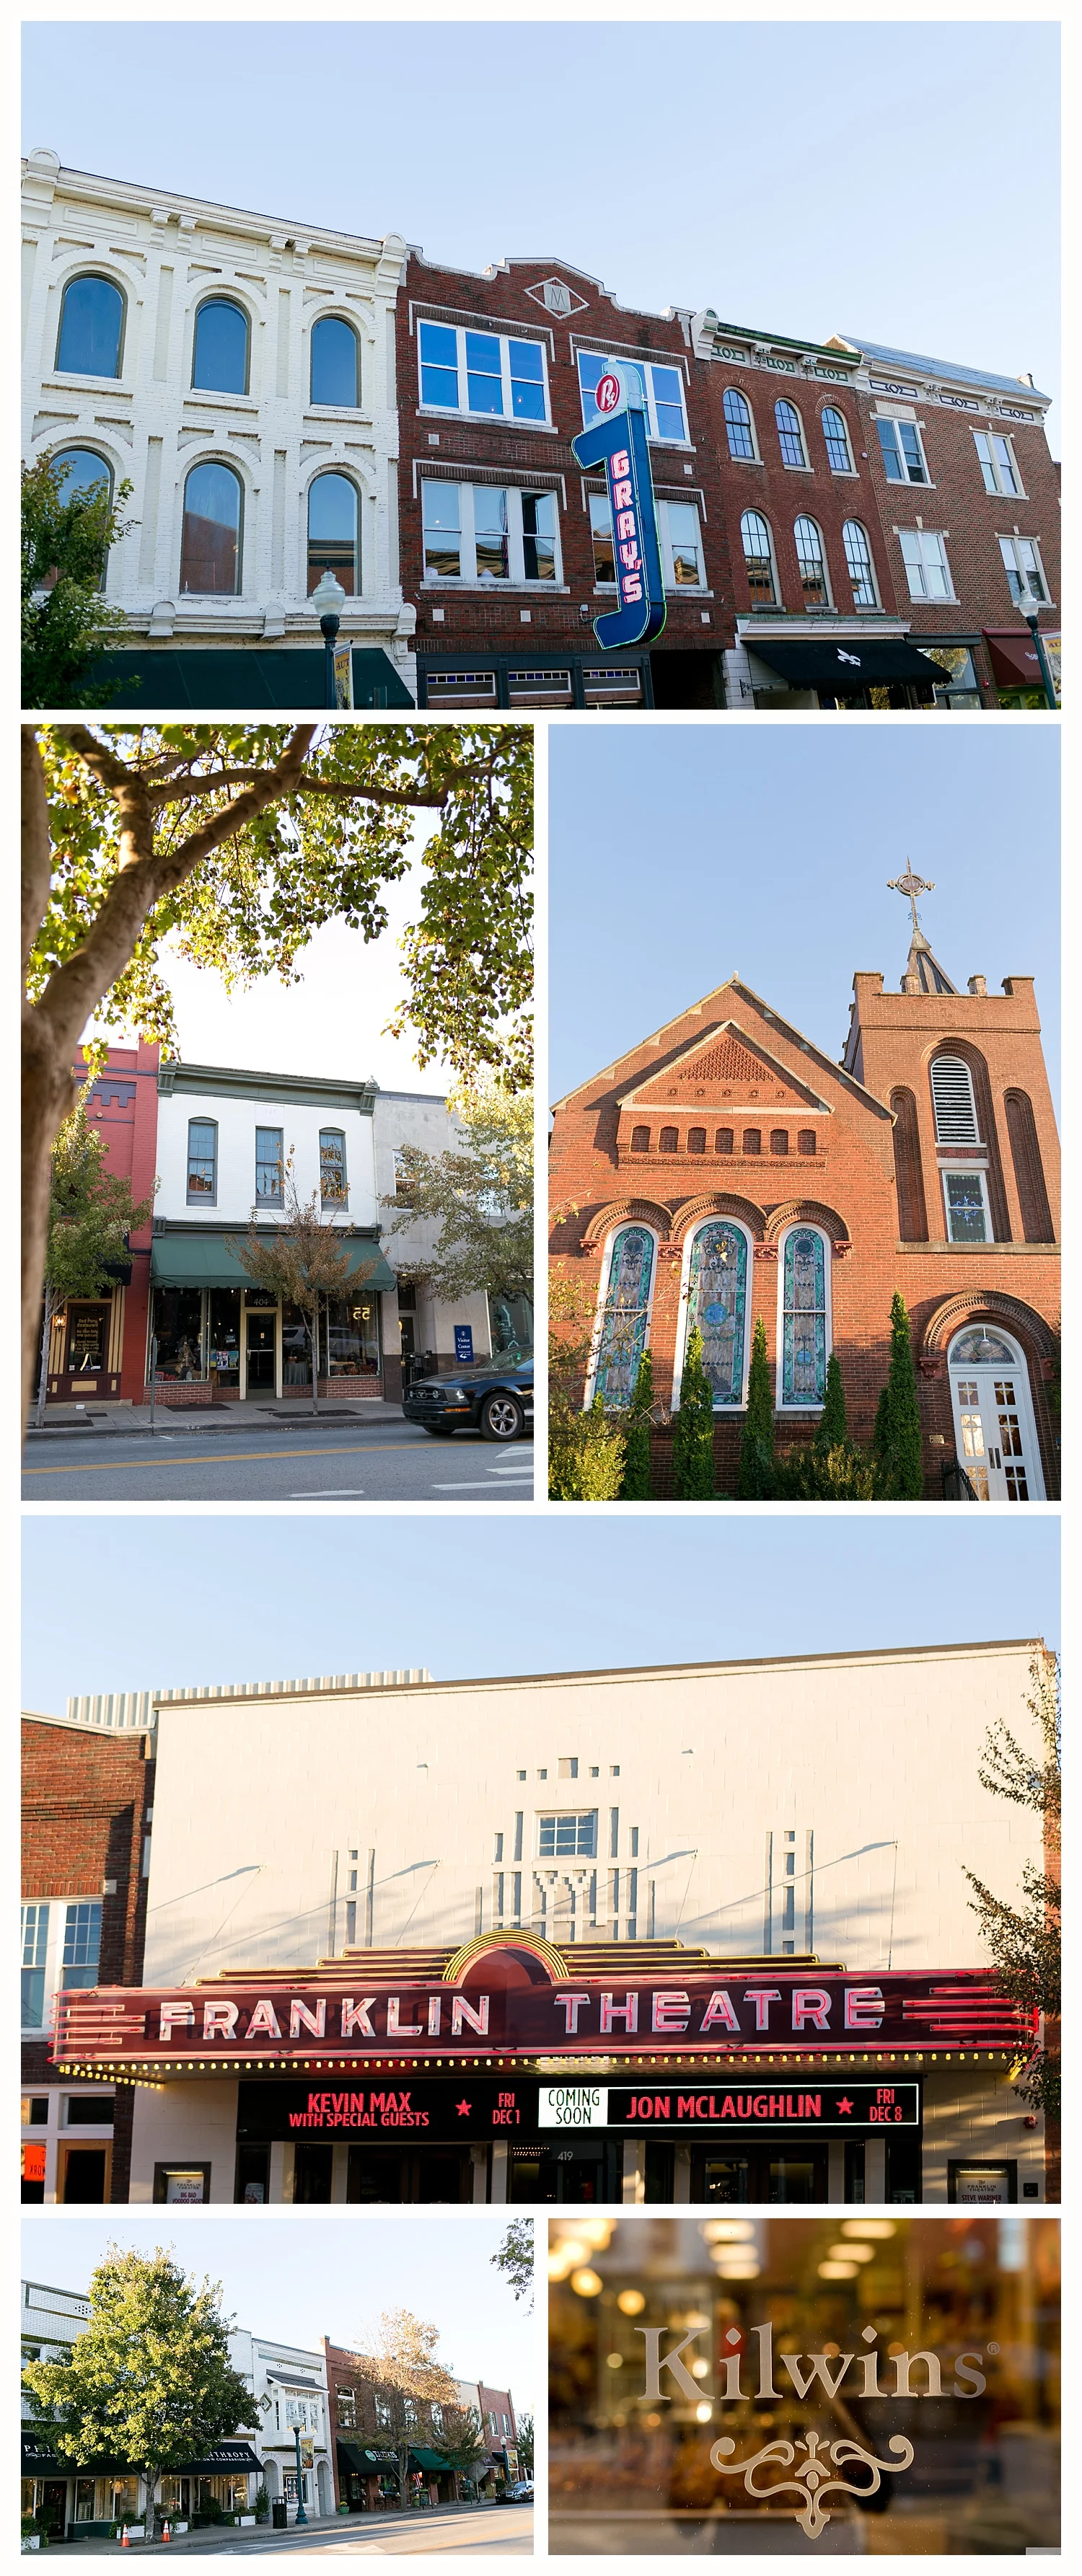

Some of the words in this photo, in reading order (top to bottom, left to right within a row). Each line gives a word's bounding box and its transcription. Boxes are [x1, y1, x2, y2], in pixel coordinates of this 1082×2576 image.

[159, 1995, 490, 2041] FRANKLIN
[553, 1987, 886, 2034] THEATRE
[308, 2092, 364, 2113] KEVIN
[370, 2091, 411, 2112] MAX
[498, 2093, 515, 2107] FRI
[548, 2088, 600, 2107] COMING
[876, 2088, 895, 2104] FRI
[625, 2096, 670, 2119] JON
[677, 2094, 822, 2119] MCLAUGHLIN
[868, 2107, 892, 2122] DEC
[894, 2106, 902, 2122] 8
[289, 2112, 324, 2127] WITH
[326, 2112, 378, 2127] SPECIAL
[380, 2111, 430, 2127] GUESTS
[492, 2109, 513, 2124] DEC
[515, 2109, 520, 2124] 1
[555, 2107, 591, 2125] SOON
[557, 2151, 573, 2161] 419
